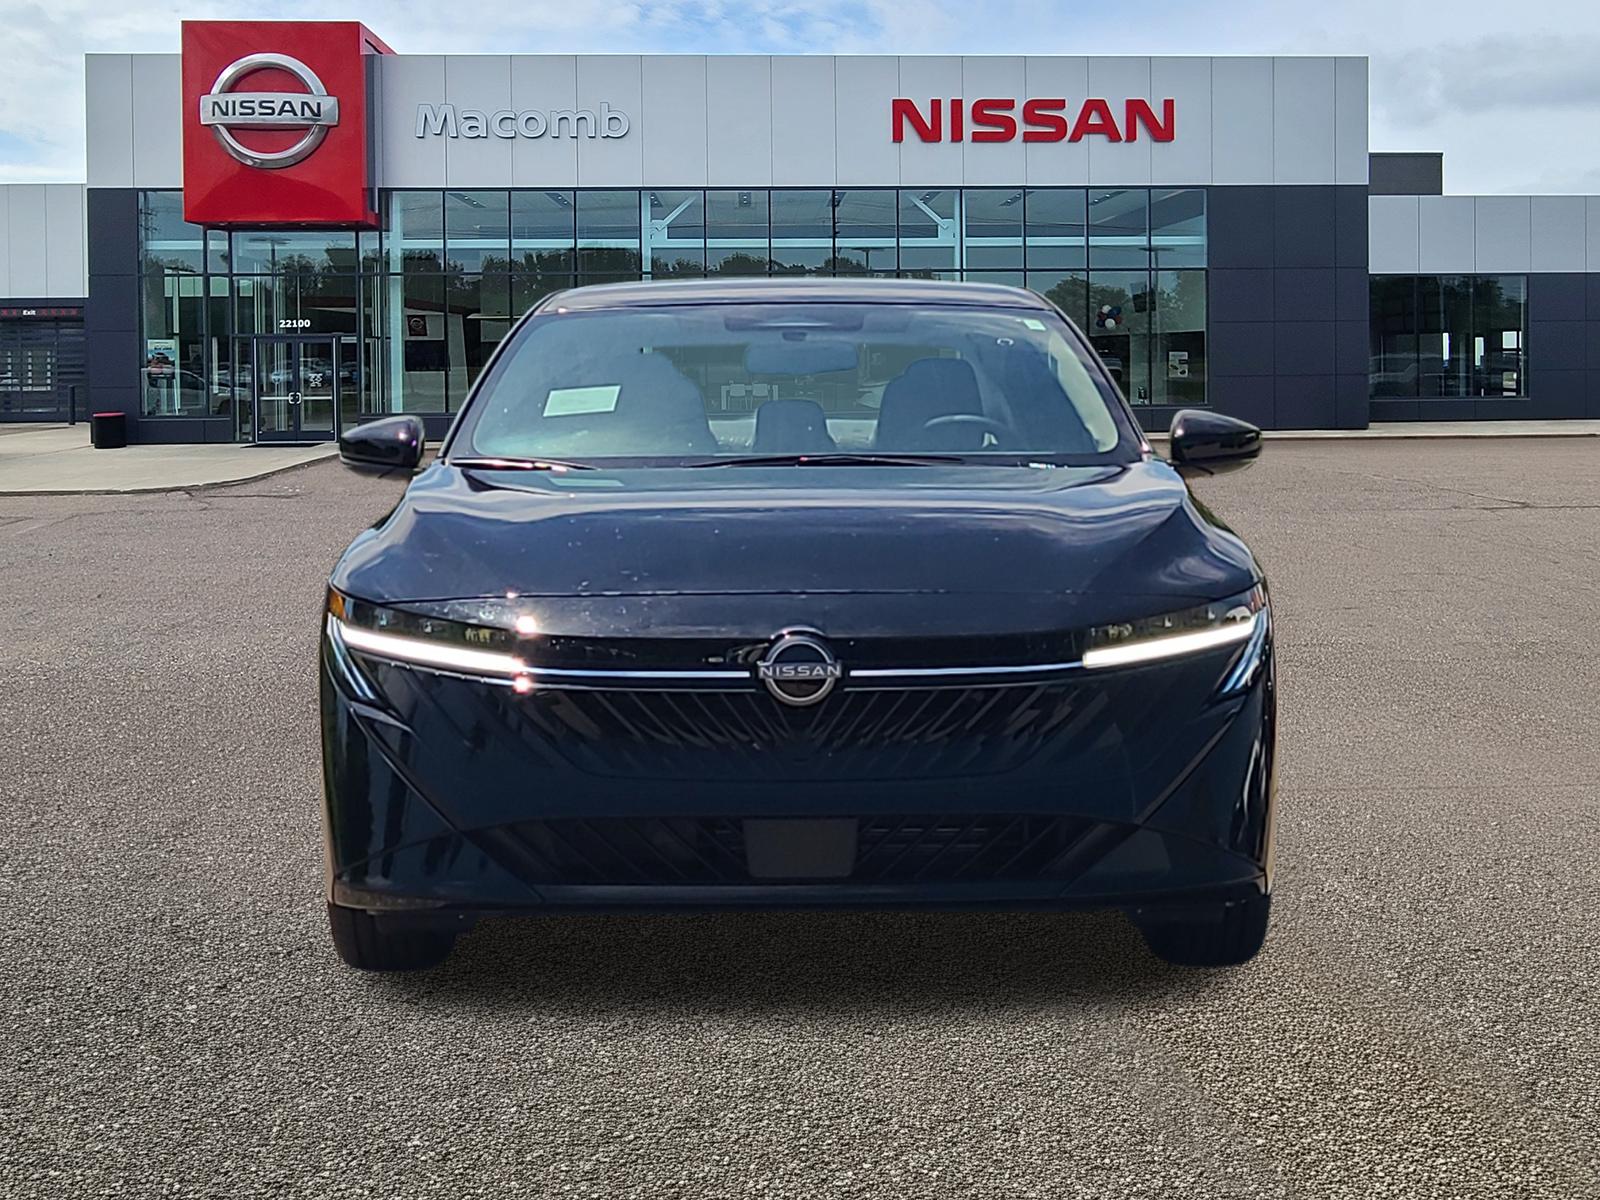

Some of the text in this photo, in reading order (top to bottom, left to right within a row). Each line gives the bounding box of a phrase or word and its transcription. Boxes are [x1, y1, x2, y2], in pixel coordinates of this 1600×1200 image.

[211, 100, 321, 118] NISSAN
[415, 102, 630, 139] Macomb
[892, 98, 1175, 143] NISSAN
[279, 319, 311, 328] 22100
[760, 665, 841, 677] NISSAN
